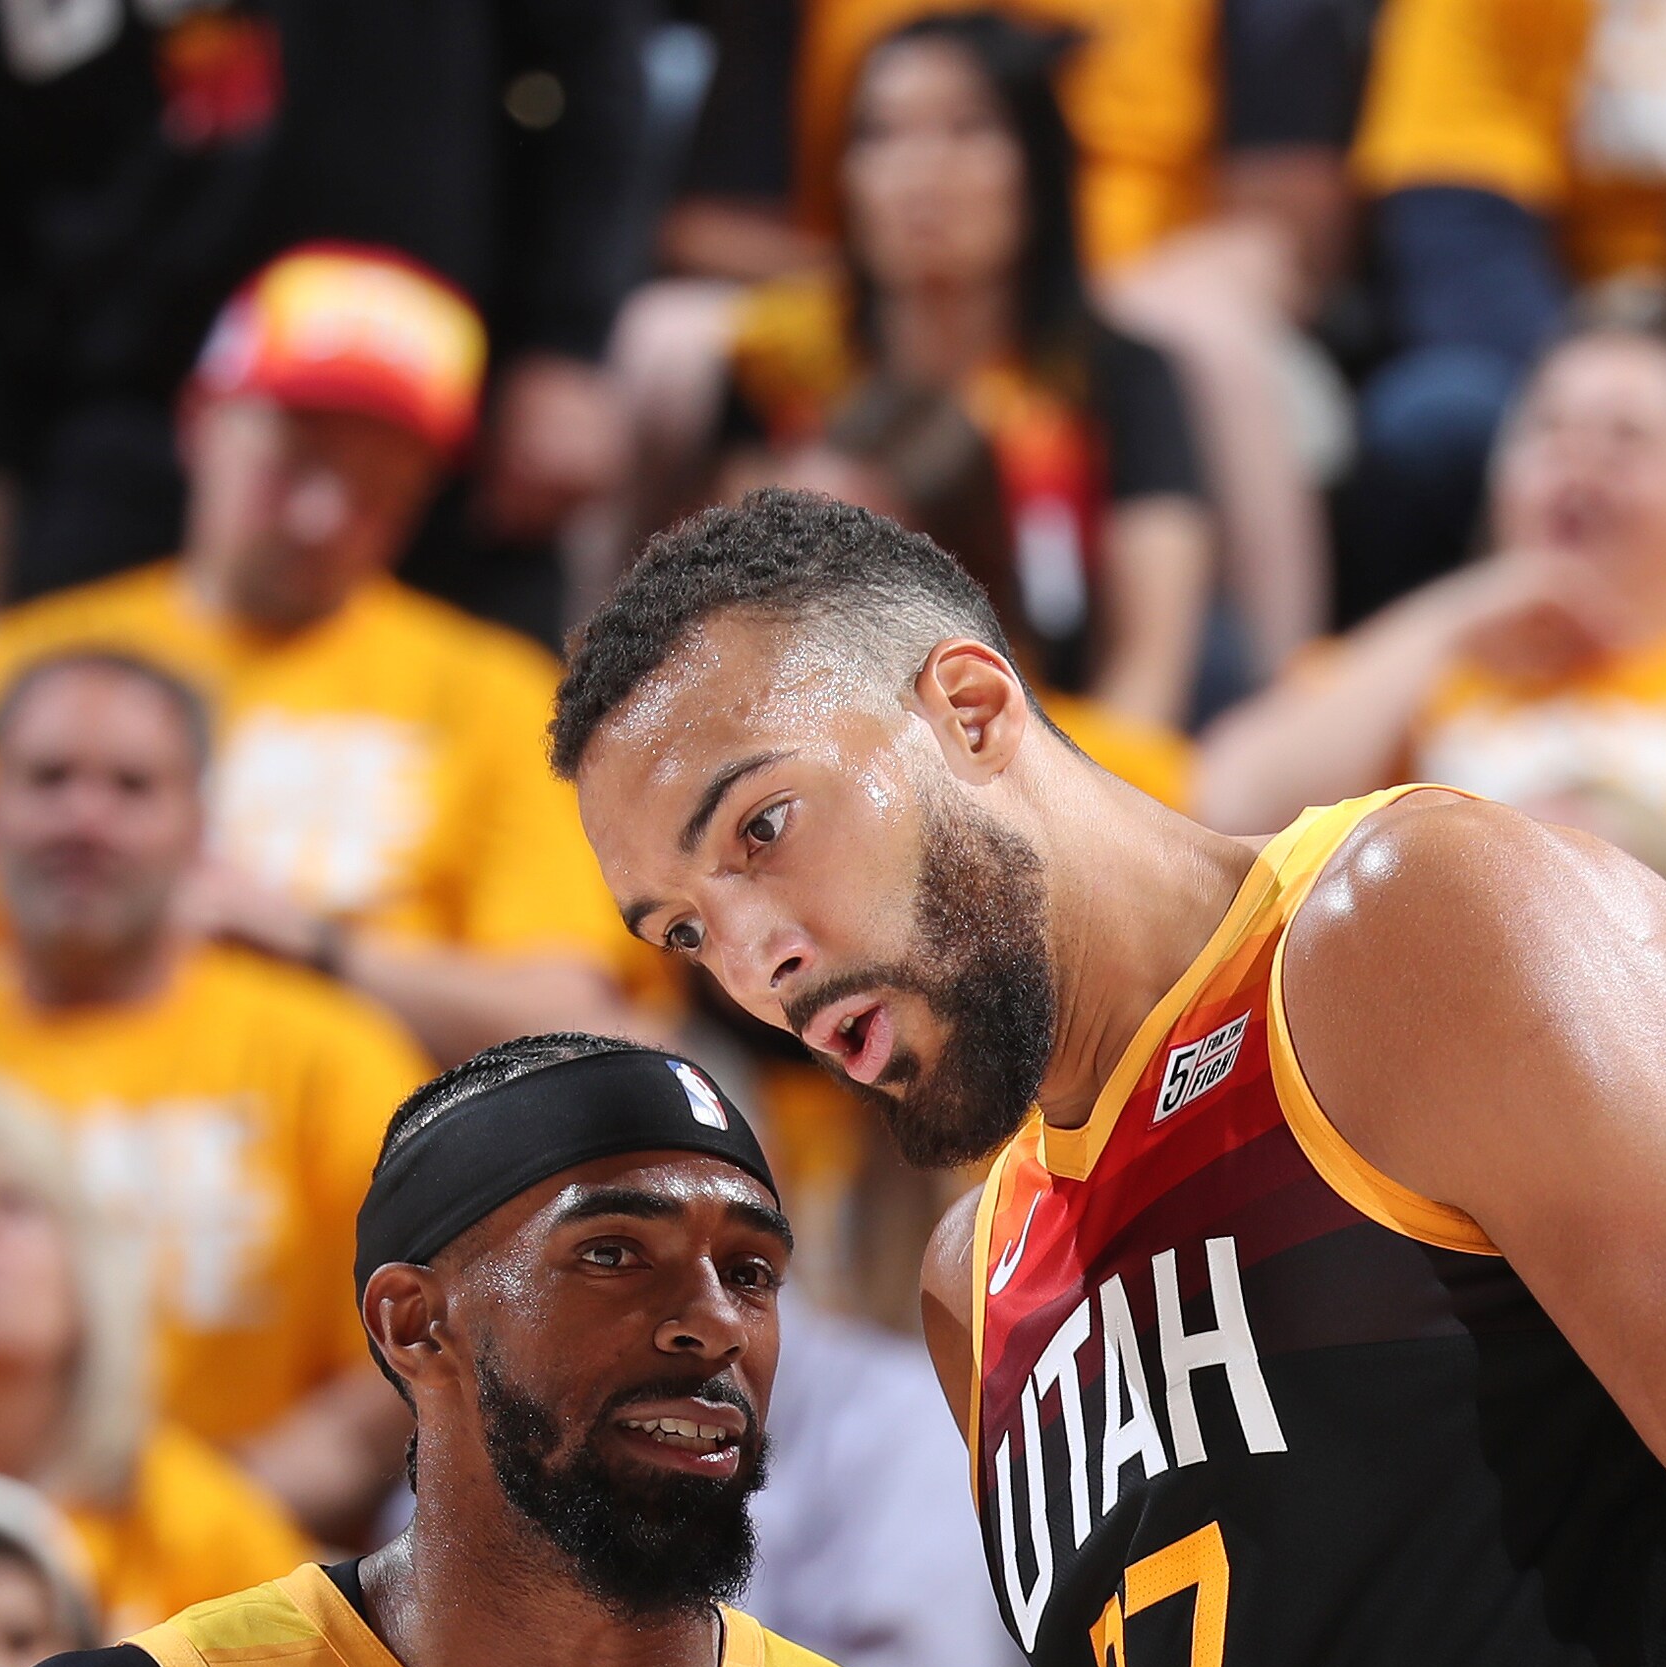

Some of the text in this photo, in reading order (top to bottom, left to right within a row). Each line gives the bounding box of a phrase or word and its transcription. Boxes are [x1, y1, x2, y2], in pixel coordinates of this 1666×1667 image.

[1162, 1048, 1197, 1112] 5
[1189, 1042, 1241, 1097] FIGHT
[996, 1236, 1287, 1653] UTAH
